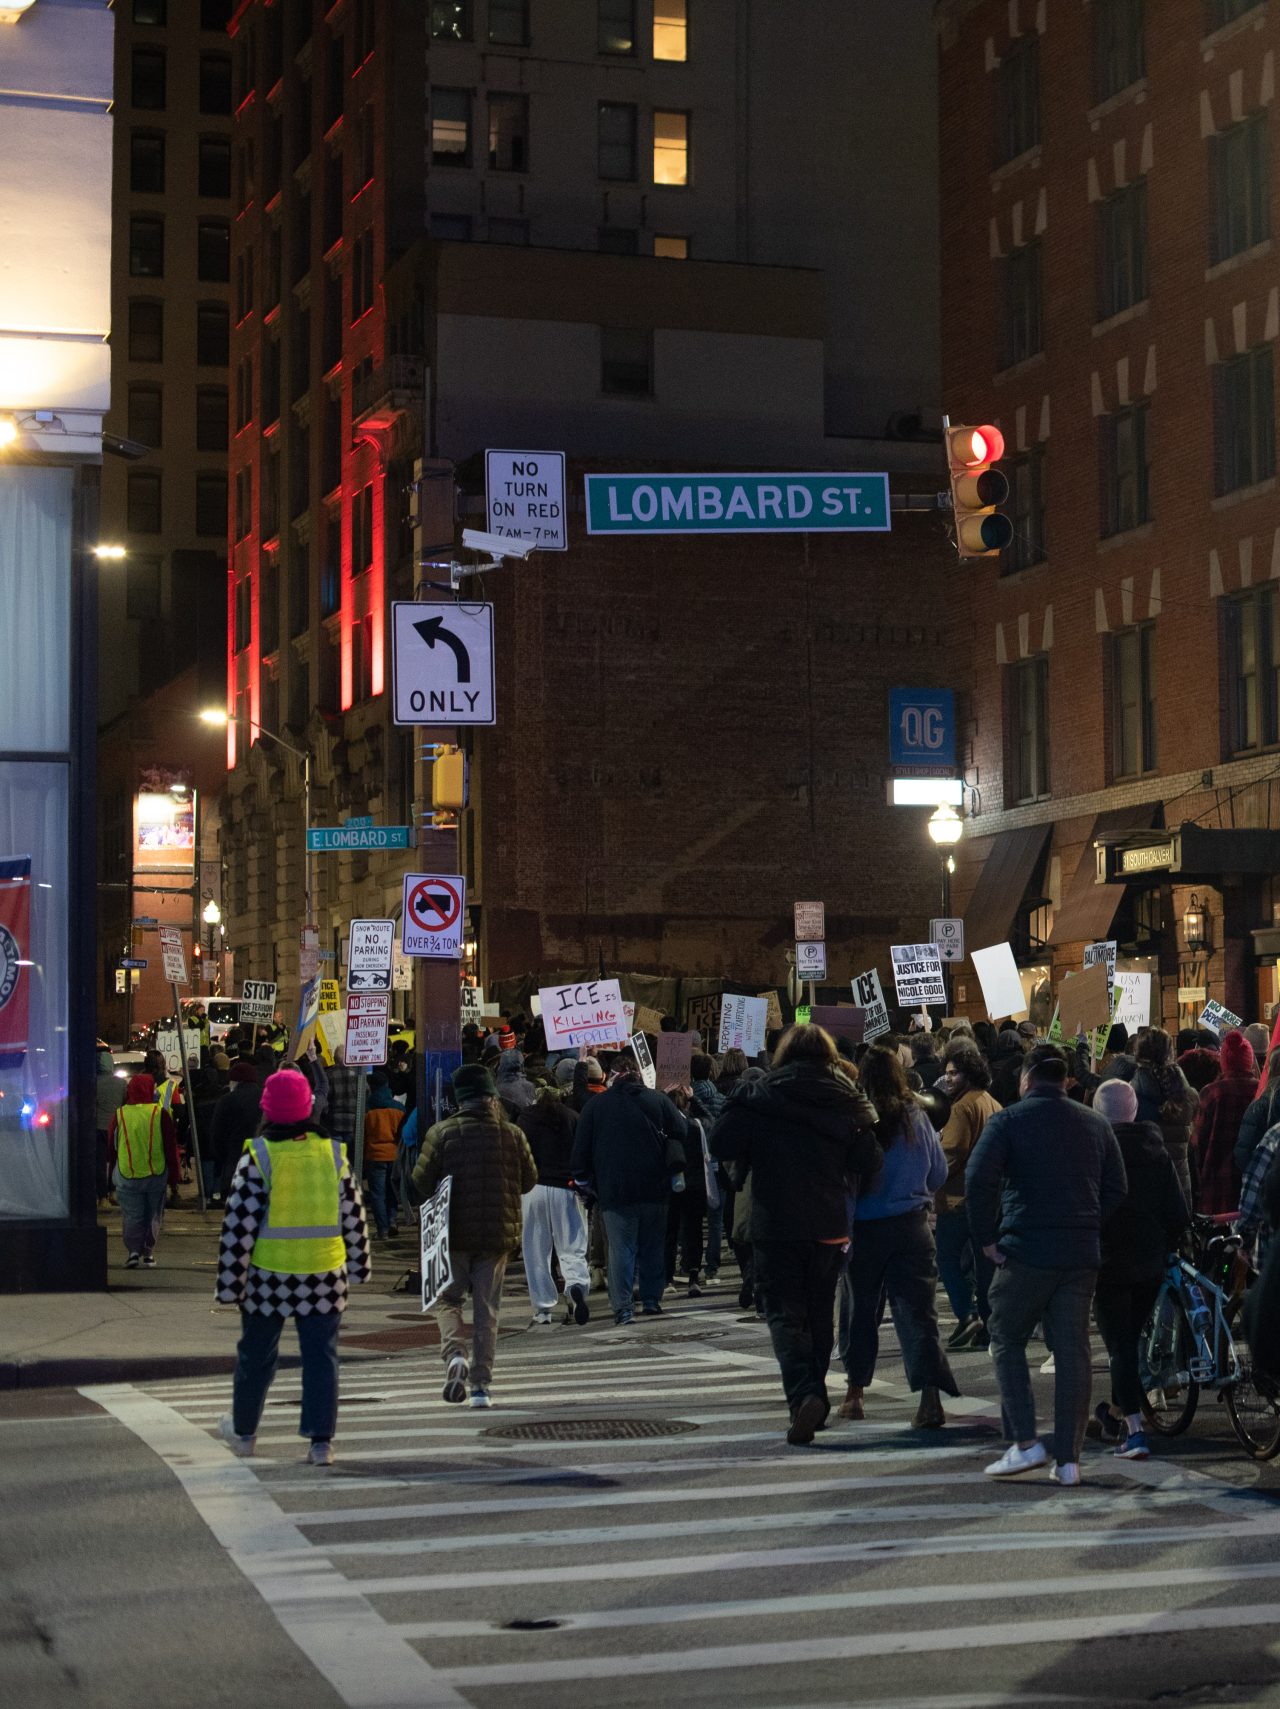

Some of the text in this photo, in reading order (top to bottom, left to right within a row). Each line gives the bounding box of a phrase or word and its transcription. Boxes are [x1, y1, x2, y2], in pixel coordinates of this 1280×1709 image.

[512, 461, 538, 477] NO
[504, 482, 548, 497] TURN
[492, 501, 560, 518] ON RED
[608, 484, 872, 522] LOMBARD ST.
[409, 690, 481, 713] ONLY
[900, 706, 945, 750] QG
[324, 830, 387, 848] LOMBARD
[1129, 851, 1149, 867] SOUTH
[1148, 848, 1172, 864] CALVER
[355, 924, 391, 932] SNOW ROUTE
[365, 934, 380, 945] NO
[407, 937, 429, 949] OVER
[442, 938, 458, 949] TON
[354, 945, 389, 956] PARKING
[895, 960, 941, 976] JUSTICE FOR
[856, 972, 878, 1007] ICE
[897, 976, 941, 987] RENEE
[243, 982, 276, 1001] STOP
[556, 982, 600, 1012] ICE
[898, 984, 944, 998] NICOLE GOOD
[326, 1002, 338, 1011] ICE
[350, 997, 387, 1009] NO STOPPING
[1207, 1000, 1222, 1013] NO
[349, 1018, 385, 1029] NO PARKING
[553, 1009, 616, 1030] KILLING
[721, 1002, 733, 1051] DEPORTING
[568, 1028, 620, 1047] PEOPLE!
